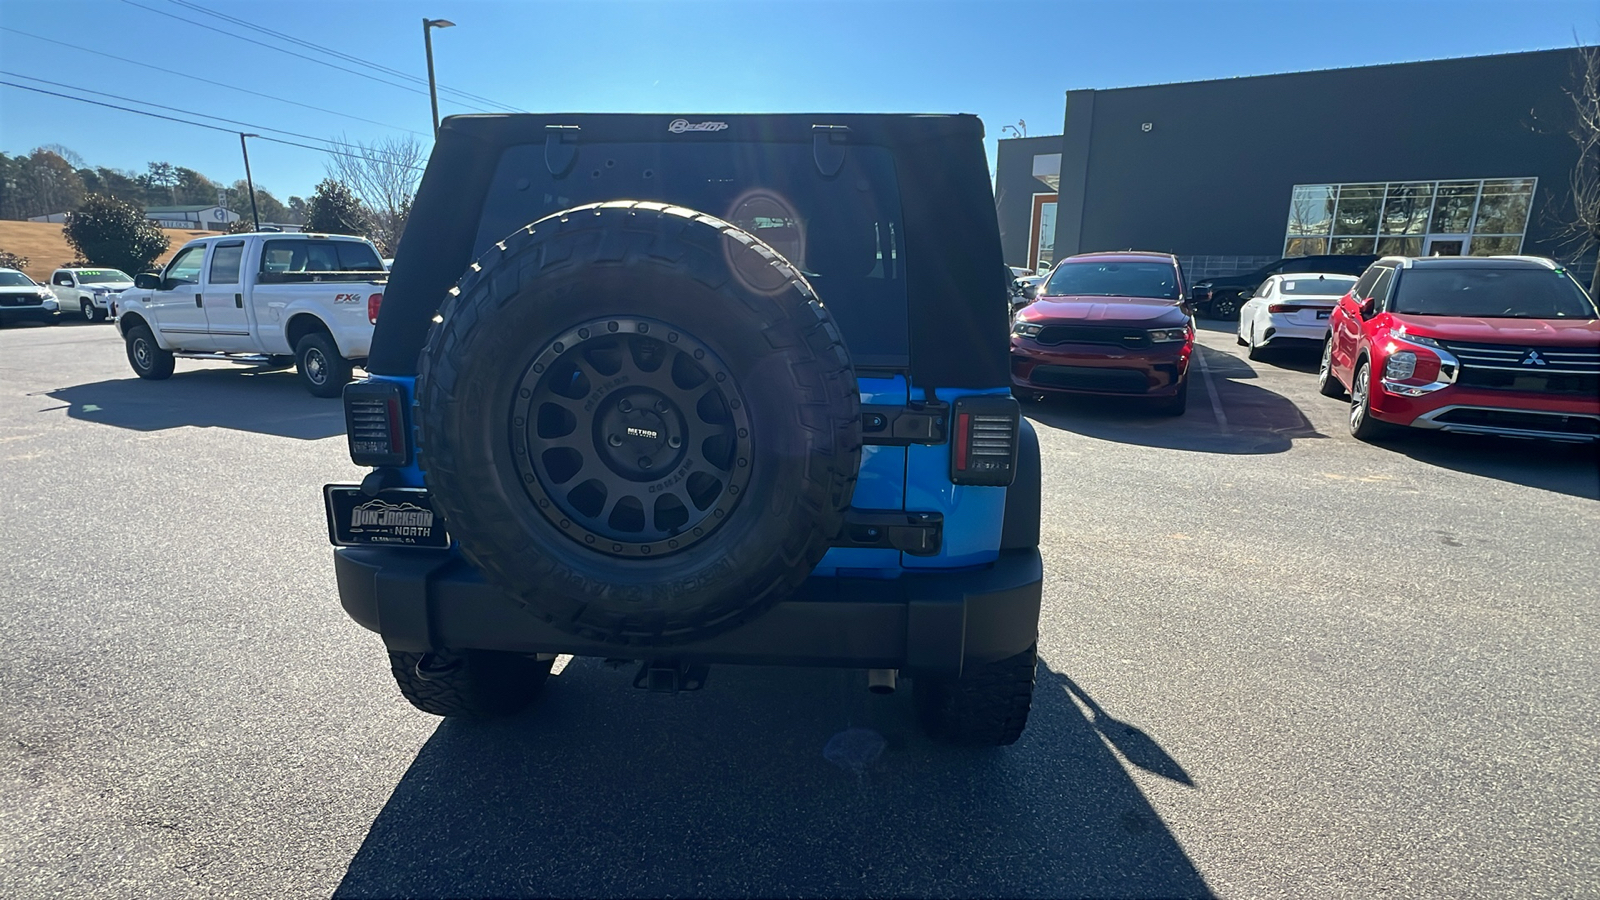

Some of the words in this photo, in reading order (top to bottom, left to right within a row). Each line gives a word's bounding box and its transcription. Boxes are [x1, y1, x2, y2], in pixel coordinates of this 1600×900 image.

[334, 293, 361, 302] FX4
[627, 427, 658, 437] METHOD
[351, 506, 378, 527] DON
[378, 509, 433, 527] JACKSON
[394, 526, 431, 537] NORTH
